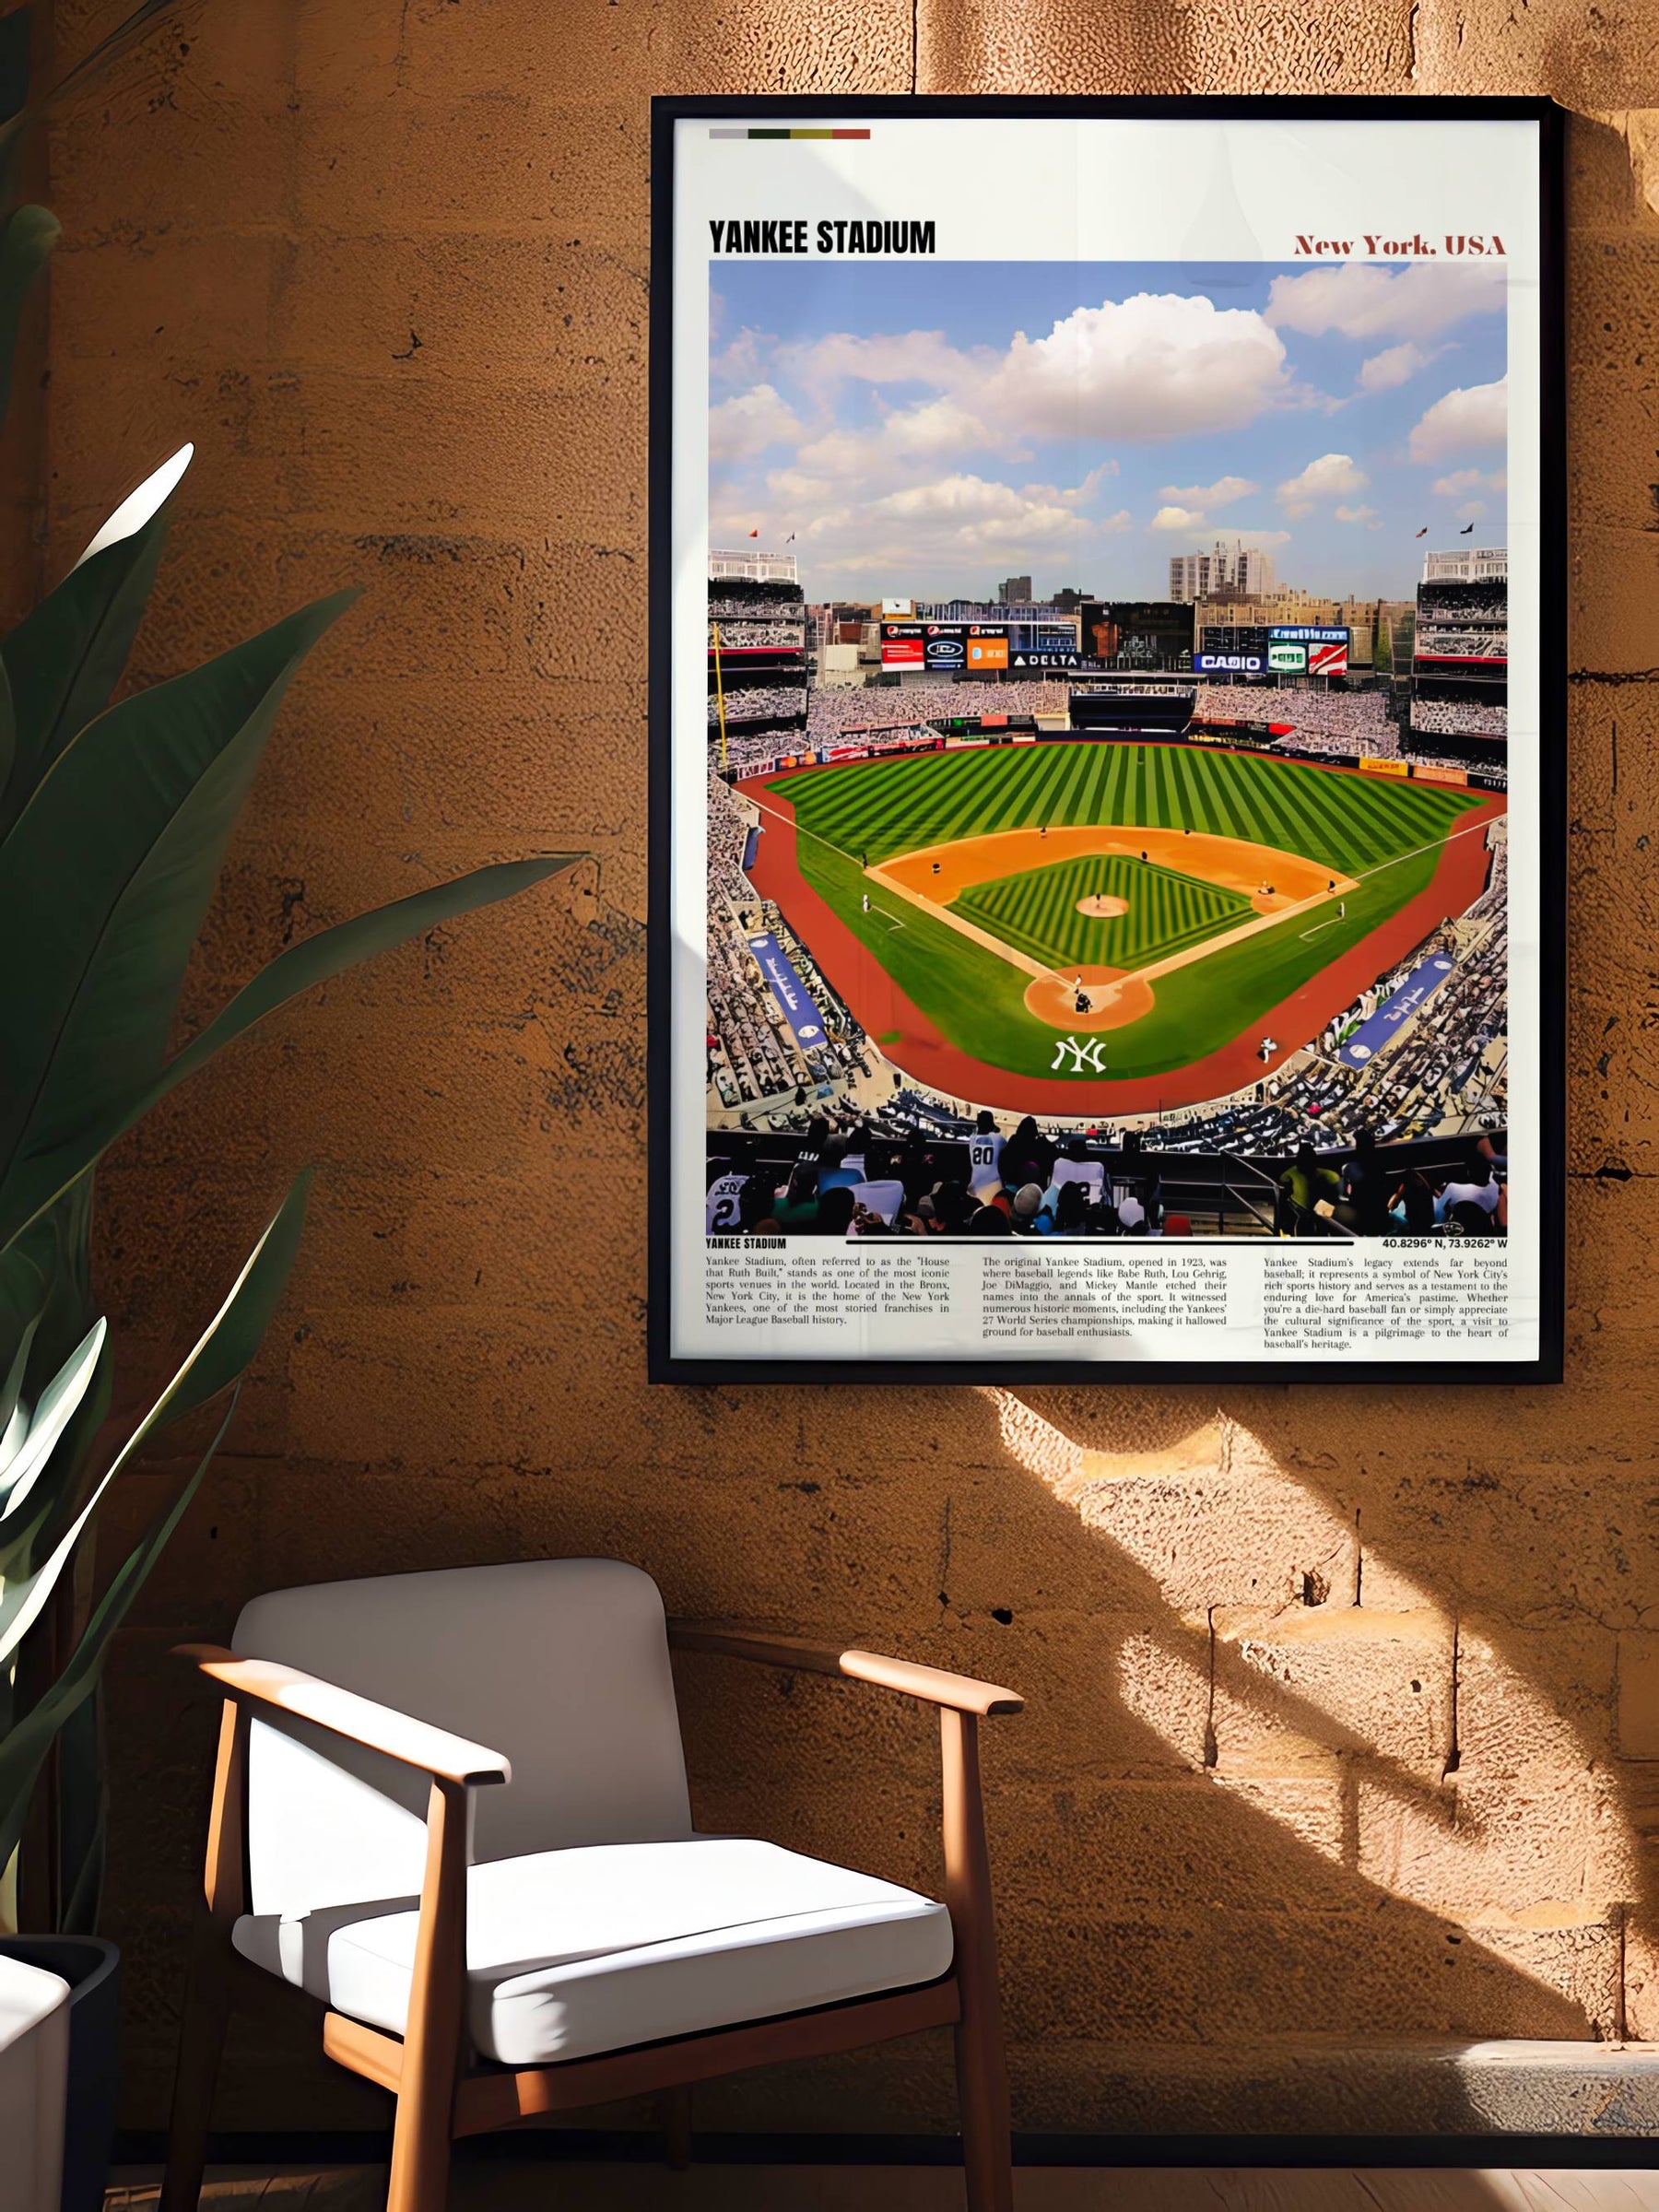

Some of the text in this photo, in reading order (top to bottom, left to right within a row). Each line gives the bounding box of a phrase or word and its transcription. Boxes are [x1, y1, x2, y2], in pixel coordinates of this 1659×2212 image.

[710, 220, 935, 253] YANKEE STADIUM
[1294, 233, 1506, 257] New York, USA
[1030, 655, 1077, 666] DELTA
[1051, 1036, 1107, 1073] NY
[706, 1238, 786, 1249] YANKEE STADIUM
[1434, 1239, 1446, 1250] N,
[1496, 1239, 1508, 1249] W
[706, 1256, 740, 1265] Yankee
[792, 1256, 816, 1265] often
[822, 1256, 861, 1265] referred
[866, 1257, 876, 1265] to
[897, 1256, 912, 1265] the
[982, 1257, 1001, 1266] The
[1004, 1257, 1041, 1268] original
[1045, 1257, 1079, 1266] Yankee
[1128, 1257, 1163, 1268] opened
[1167, 1257, 1177, 1266] in
[1264, 1257, 1298, 1266] Yankee
[1364, 1257, 1394, 1269] legacy
[1403, 1257, 1440, 1266] extends
[1450, 1257, 1465, 1266] far
[1474, 1257, 1508, 1269] beyond
[705, 1268, 724, 1277] that
[728, 1268, 750, 1277] Ruth
[786, 1268, 818, 1277] stands
[859, 1268, 870, 1277] of
[874, 1268, 888, 1277] the
[893, 1269, 916, 1277] most
[922, 1268, 950, 1277] iconic
[982, 1269, 1011, 1278] where
[1015, 1269, 1053, 1278] baseball
[1057, 1269, 1093, 1280] legends
[1097, 1269, 1113, 1278] like
[1117, 1269, 1140, 1278] Babe
[1171, 1269, 1189, 1278] Lou
[1309, 1269, 1315, 1278] it
[1319, 1270, 1369, 1280] represents
[1382, 1269, 1416, 1280] symbol
[1419, 1269, 1431, 1278] of
[1433, 1269, 1453, 1278] New
[1457, 1269, 1479, 1278] York
[705, 1281, 735, 1291] sports
[777, 1280, 786, 1289] in
[791, 1280, 806, 1289] the
[844, 1280, 880, 1289] Located
[885, 1280, 895, 1289] in
[900, 1280, 914, 1289] the
[981, 1280, 997, 1292] Joe
[1059, 1280, 1077, 1289] and
[1086, 1280, 1118, 1292] Mickey
[1125, 1280, 1159, 1289] Mantle
[1165, 1280, 1196, 1289] etched
[1205, 1280, 1228, 1289] their
[1265, 1281, 1285, 1290] rich
[1286, 1282, 1315, 1292] sports
[1318, 1281, 1351, 1292] history
[1354, 1281, 1372, 1290] and
[1430, 1282, 1477, 1290] testament
[1480, 1282, 1490, 1290] to
[1493, 1281, 1508, 1290] the
[1019, 1292, 1040, 1301] into
[1043, 1292, 1059, 1301] the
[1064, 1292, 1096, 1301] annals
[1101, 1292, 1112, 1301] of
[1116, 1292, 1132, 1301] the
[1169, 1292, 1176, 1301] It
[1181, 1292, 1227, 1301] witnessed
[1264, 1293, 1308, 1304] enduring
[1315, 1293, 1335, 1301] love
[1343, 1293, 1358, 1301] for
[1466, 1293, 1509, 1301] Whether
[777, 1303, 788, 1312] of
[794, 1303, 809, 1312] the
[815, 1304, 839, 1312] most
[845, 1303, 877, 1312] storied
[884, 1303, 933, 1312] franchises
[940, 1303, 949, 1312] in
[1033, 1304, 1070, 1313] historic
[1122, 1304, 1167, 1315] including
[1169, 1304, 1184, 1313] the
[1304, 1304, 1345, 1313] die-hard
[1348, 1304, 1387, 1313] baseball
[1391, 1304, 1406, 1313] fan
[1424, 1304, 1456, 1315] simply
[1458, 1304, 1508, 1315] appreciate
[706, 1315, 734, 1326] Major
[735, 1315, 769, 1326] League
[771, 1315, 809, 1324] Baseball
[982, 1316, 994, 1324] 27
[996, 1316, 1027, 1324] World
[1030, 1316, 1058, 1324] Series
[1138, 1316, 1174, 1327] making
[1176, 1316, 1182, 1324] it
[1185, 1316, 1227, 1324] hallowed
[1263, 1328, 1298, 1337] Yankee
[1303, 1328, 1343, 1337] Stadium
[1349, 1328, 1357, 1337] is
[1375, 1328, 1426, 1339] pilgrimage
[1431, 1328, 1441, 1337] to
[1446, 1328, 1462, 1337] the
[1467, 1328, 1492, 1337] heart
[1498, 1328, 1509, 1337] of
